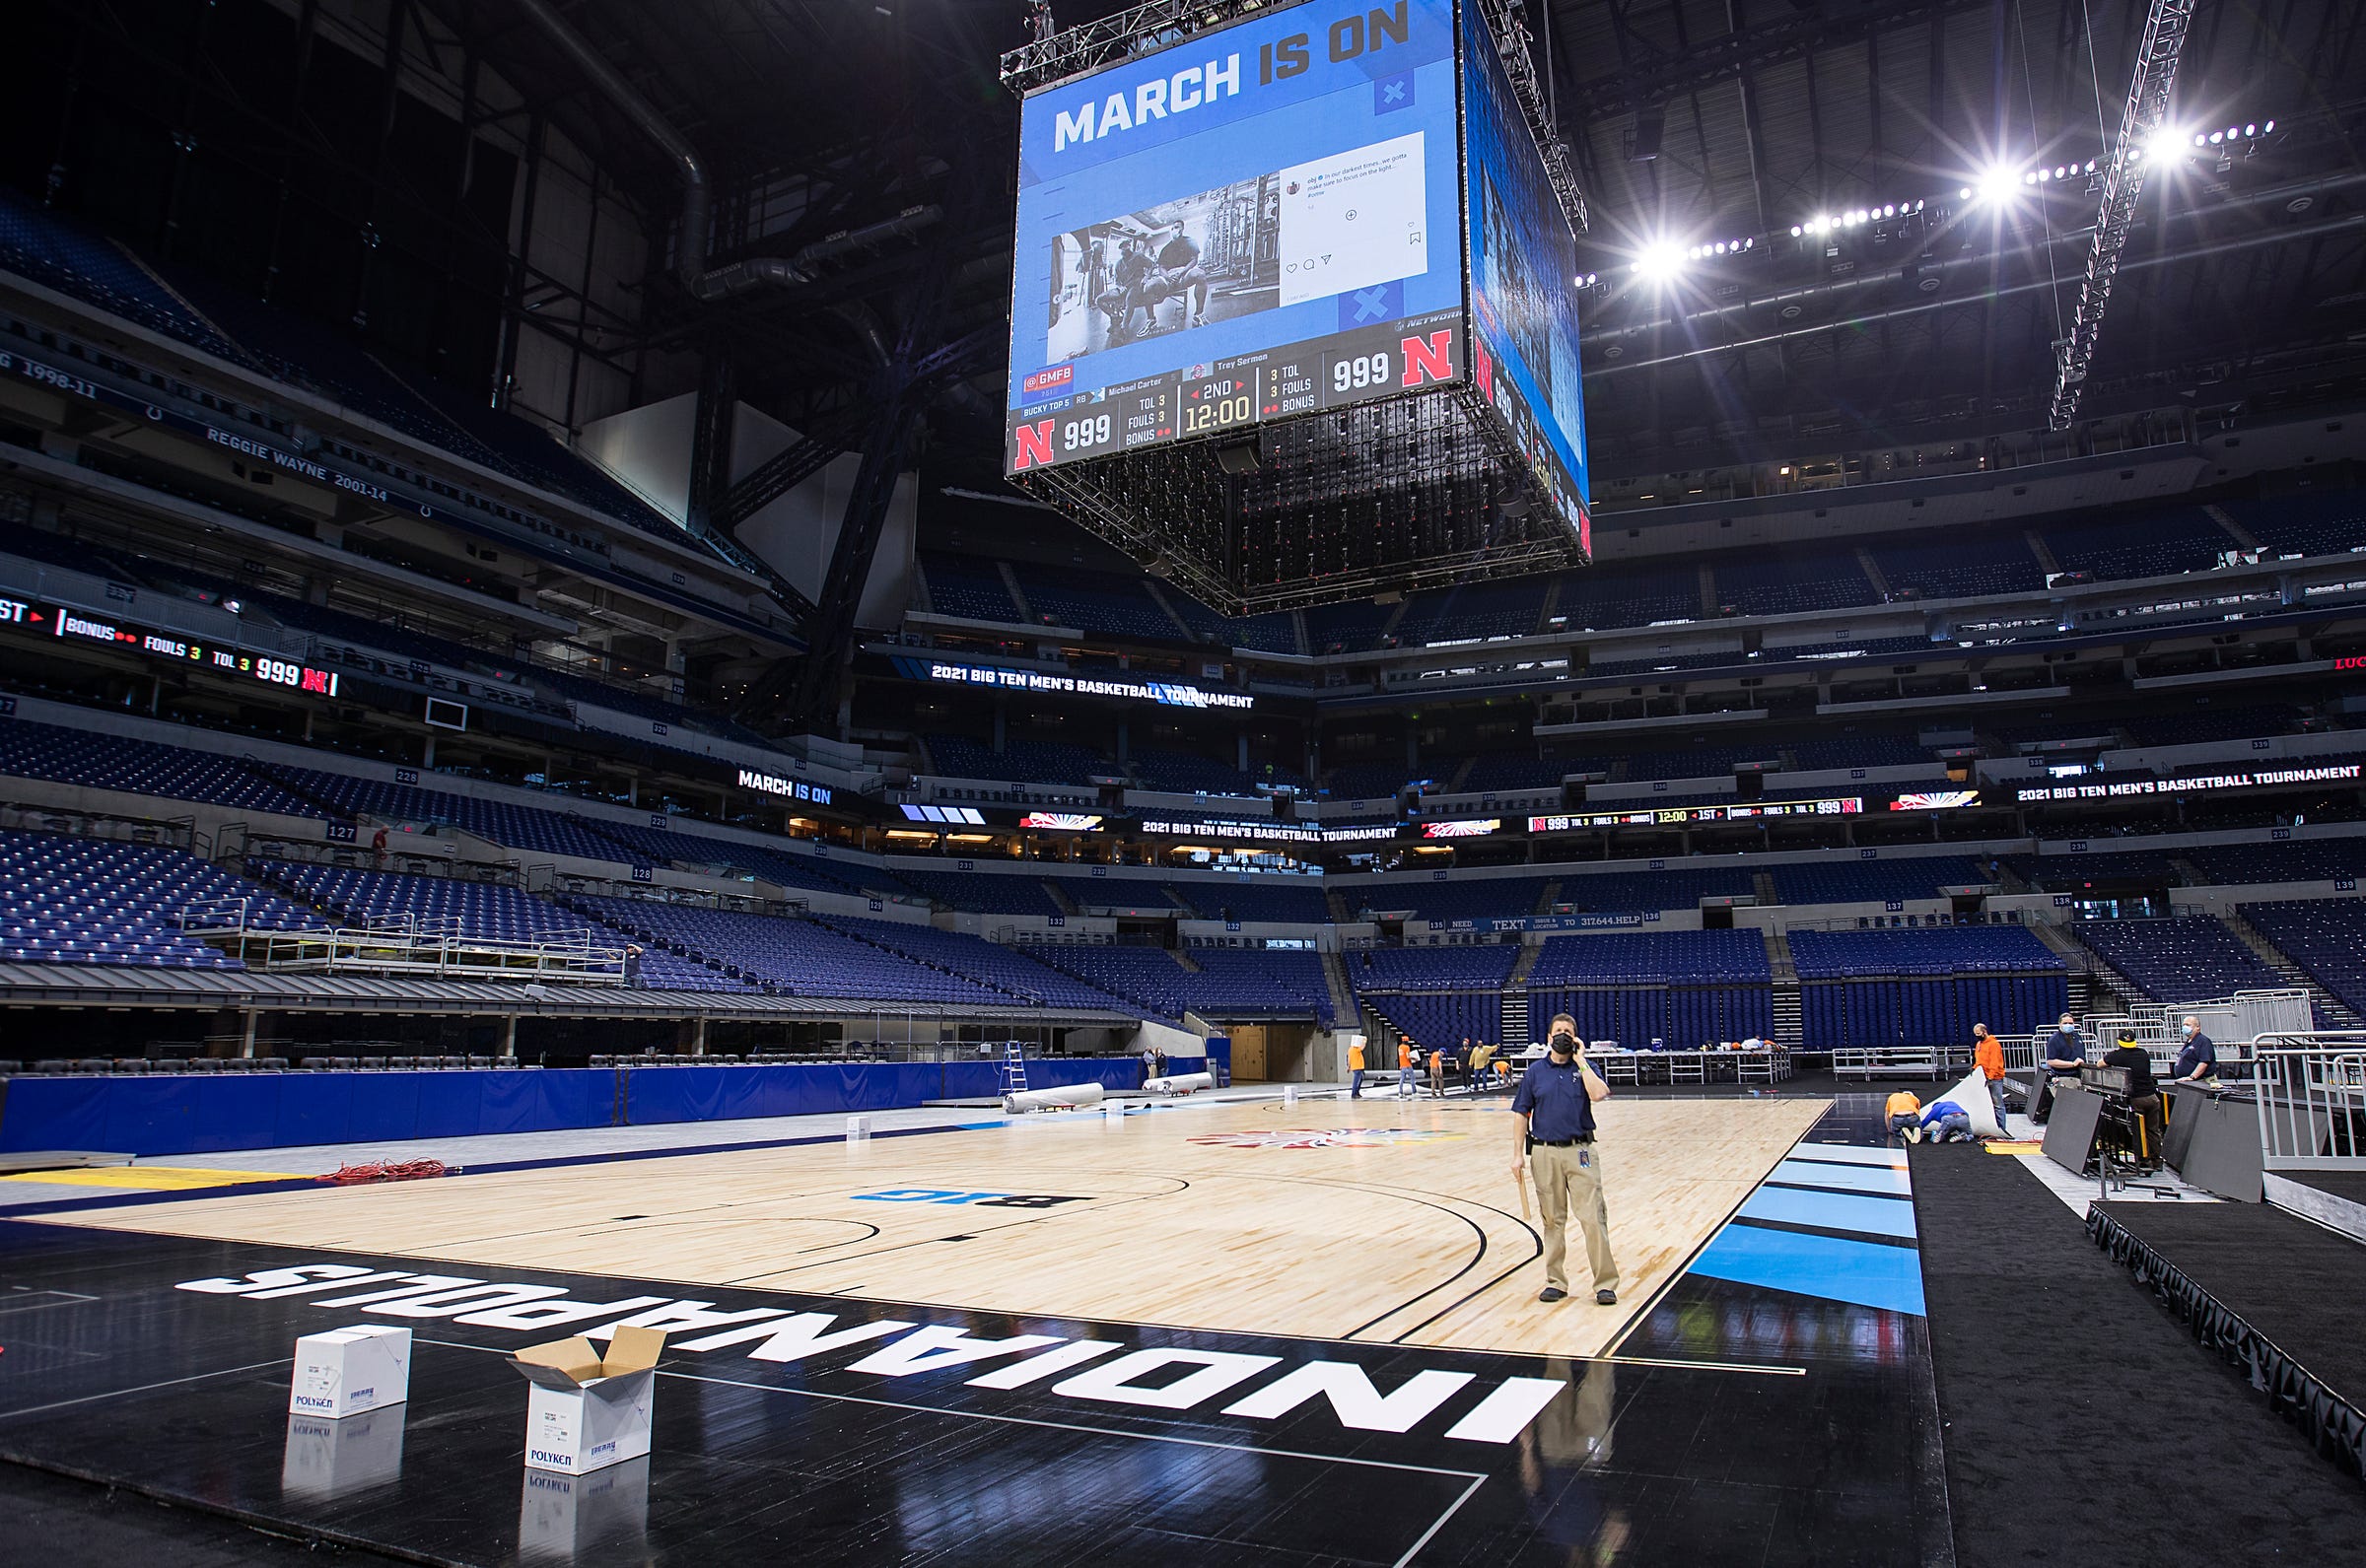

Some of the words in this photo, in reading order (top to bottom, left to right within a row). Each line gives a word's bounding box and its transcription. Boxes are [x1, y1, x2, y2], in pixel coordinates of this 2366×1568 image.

[1055, 53, 1239, 153] MARCH
[1260, 33, 1309, 86] IS
[1329, 0, 1409, 63] ON
[1342, 165, 1362, 175] darkest
[1218, 361, 1236, 372] Trey
[1237, 353, 1268, 368] Sermon
[1401, 329, 1453, 387] N
[22, 362, 97, 400] 1998-11
[1039, 368, 1072, 384] GMFB
[1271, 370, 1278, 380] 3
[1282, 365, 1299, 378] TOL
[1334, 353, 1389, 392] 999
[1108, 383, 1137, 396] Michael
[1138, 377, 1162, 389] Carter
[1204, 380, 1231, 399] 2ND
[1271, 386, 1278, 398] 3
[1283, 378, 1311, 395] FOULS
[1023, 404, 1048, 417] BUCKY
[1049, 400, 1064, 411] TOP
[1077, 395, 1086, 404] RB
[1140, 397, 1155, 410] TOL
[1158, 394, 1165, 406] 3
[1283, 395, 1314, 412] BONUS
[1496, 376, 1512, 426] 999
[1128, 413, 1154, 430] FOULS
[1158, 411, 1165, 423] 3
[1186, 396, 1250, 432] 12:00
[1065, 414, 1111, 451] 999
[1126, 430, 1155, 445] BONUS
[1014, 419, 1055, 470] N
[207, 427, 268, 460] REGGIE
[273, 451, 326, 481] WAYNE
[334, 473, 387, 503] 2001-14
[65, 617, 116, 642] BONUS
[144, 635, 185, 657] FOULS
[190, 646, 201, 660] 3
[213, 650, 236, 667] TOL
[239, 657, 250, 671] 3
[256, 657, 299, 686] 999
[301, 667, 329, 694] N
[2334, 655, 2366, 670] LUC
[932, 665, 967, 681] 2021
[971, 669, 996, 683] BIG
[998, 671, 1026, 687] TEN
[1030, 675, 1074, 691] MEN'S
[1077, 679, 1163, 700] BASKETBALL
[1165, 688, 1254, 709] TOURNAMENT
[654, 724, 666, 734] 329
[2253, 740, 2268, 749] 339
[397, 772, 417, 783] 228
[2018, 788, 2051, 802] 2021
[2053, 787, 2077, 799] BIG
[2078, 785, 2106, 797] TEN
[2110, 781, 2155, 795] MEN'S
[2157, 775, 2253, 792] BASKETBALL
[2254, 765, 2361, 785] TOURNAMENT
[738, 770, 793, 796] MARCH
[795, 784, 809, 800] IS
[811, 788, 832, 805] ON
[652, 817, 665, 826] 229
[1534, 818, 1546, 831] N
[1548, 818, 1568, 831] 999
[1658, 811, 1687, 823] 12:00
[1698, 809, 1716, 820] 1ST
[1764, 806, 1783, 815] FOULS
[1784, 805, 1790, 814] 3
[1817, 801, 1840, 814] 999
[1843, 799, 1855, 813] N
[329, 826, 355, 839] 127
[1143, 822, 1170, 833] 2021
[1172, 823, 1191, 835] BIG
[1193, 824, 1216, 836] TEN
[1218, 826, 1251, 838] MEN'S
[1254, 829, 1320, 842] BASKETBALL
[1322, 828, 1397, 842] TOURNAMENT
[2273, 829, 2289, 838] 239
[634, 868, 652, 879] 128
[2335, 880, 2354, 889] 139
[1887, 901, 1902, 910] 137
[1493, 920, 1526, 930] TEXT
[175, 1264, 1566, 1444] INDIANAPOLIS
[296, 1396, 332, 1407] POLYKEN
[531, 1450, 572, 1466] POLYKEN
